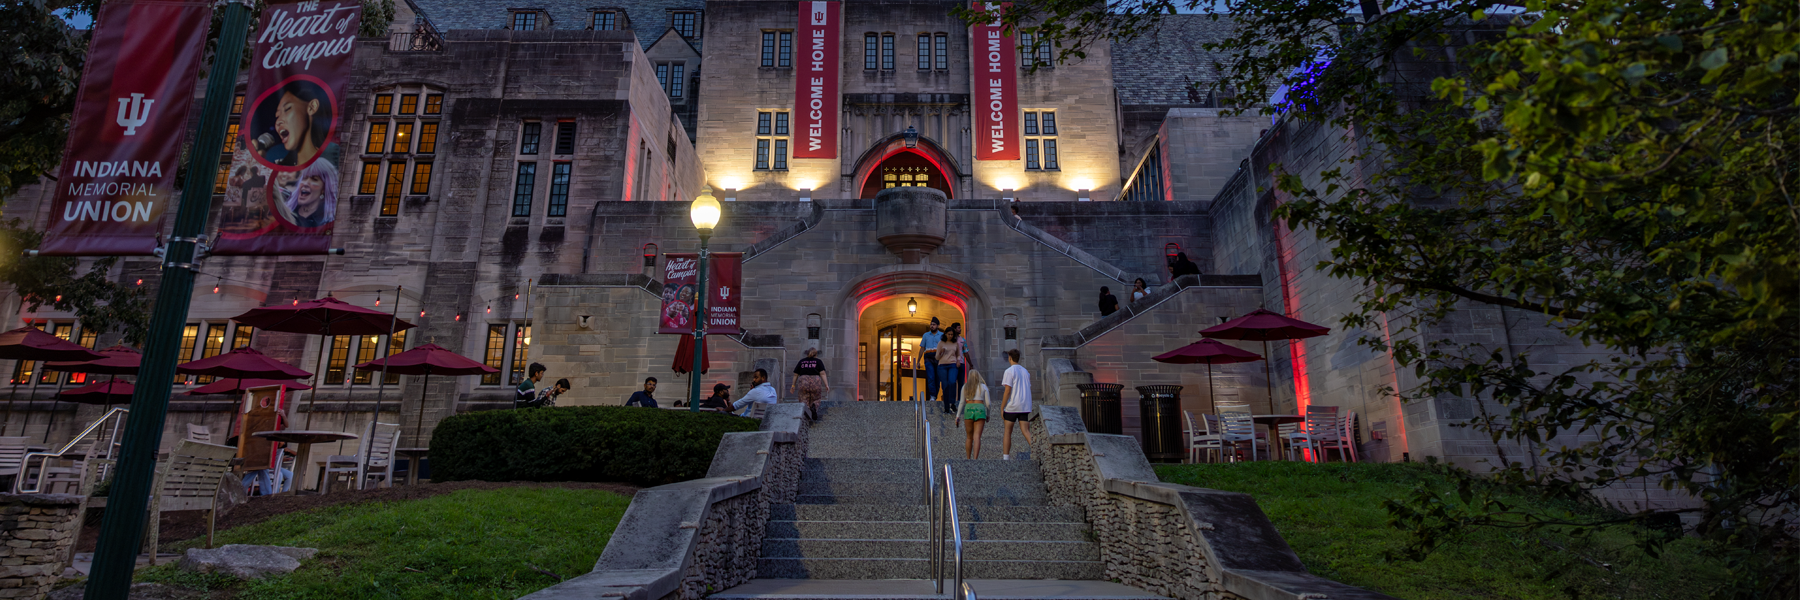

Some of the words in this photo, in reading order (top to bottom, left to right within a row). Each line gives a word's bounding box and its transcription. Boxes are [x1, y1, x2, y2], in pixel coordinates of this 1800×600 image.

[296, 0, 320, 13] THE
[258, 3, 360, 43] Heart
[335, 12, 355, 34] of
[262, 35, 356, 70] Campus
[811, 29, 825, 71] HOME
[988, 30, 1001, 73] HOME
[809, 77, 824, 151] WELCOME
[990, 78, 1004, 153] WELCOME
[73, 160, 162, 178] INDIANA
[68, 182, 157, 197] MEMORIAL
[63, 200, 153, 222] UNION
[665, 258, 697, 271] Heart
[667, 269, 697, 280] Campus
